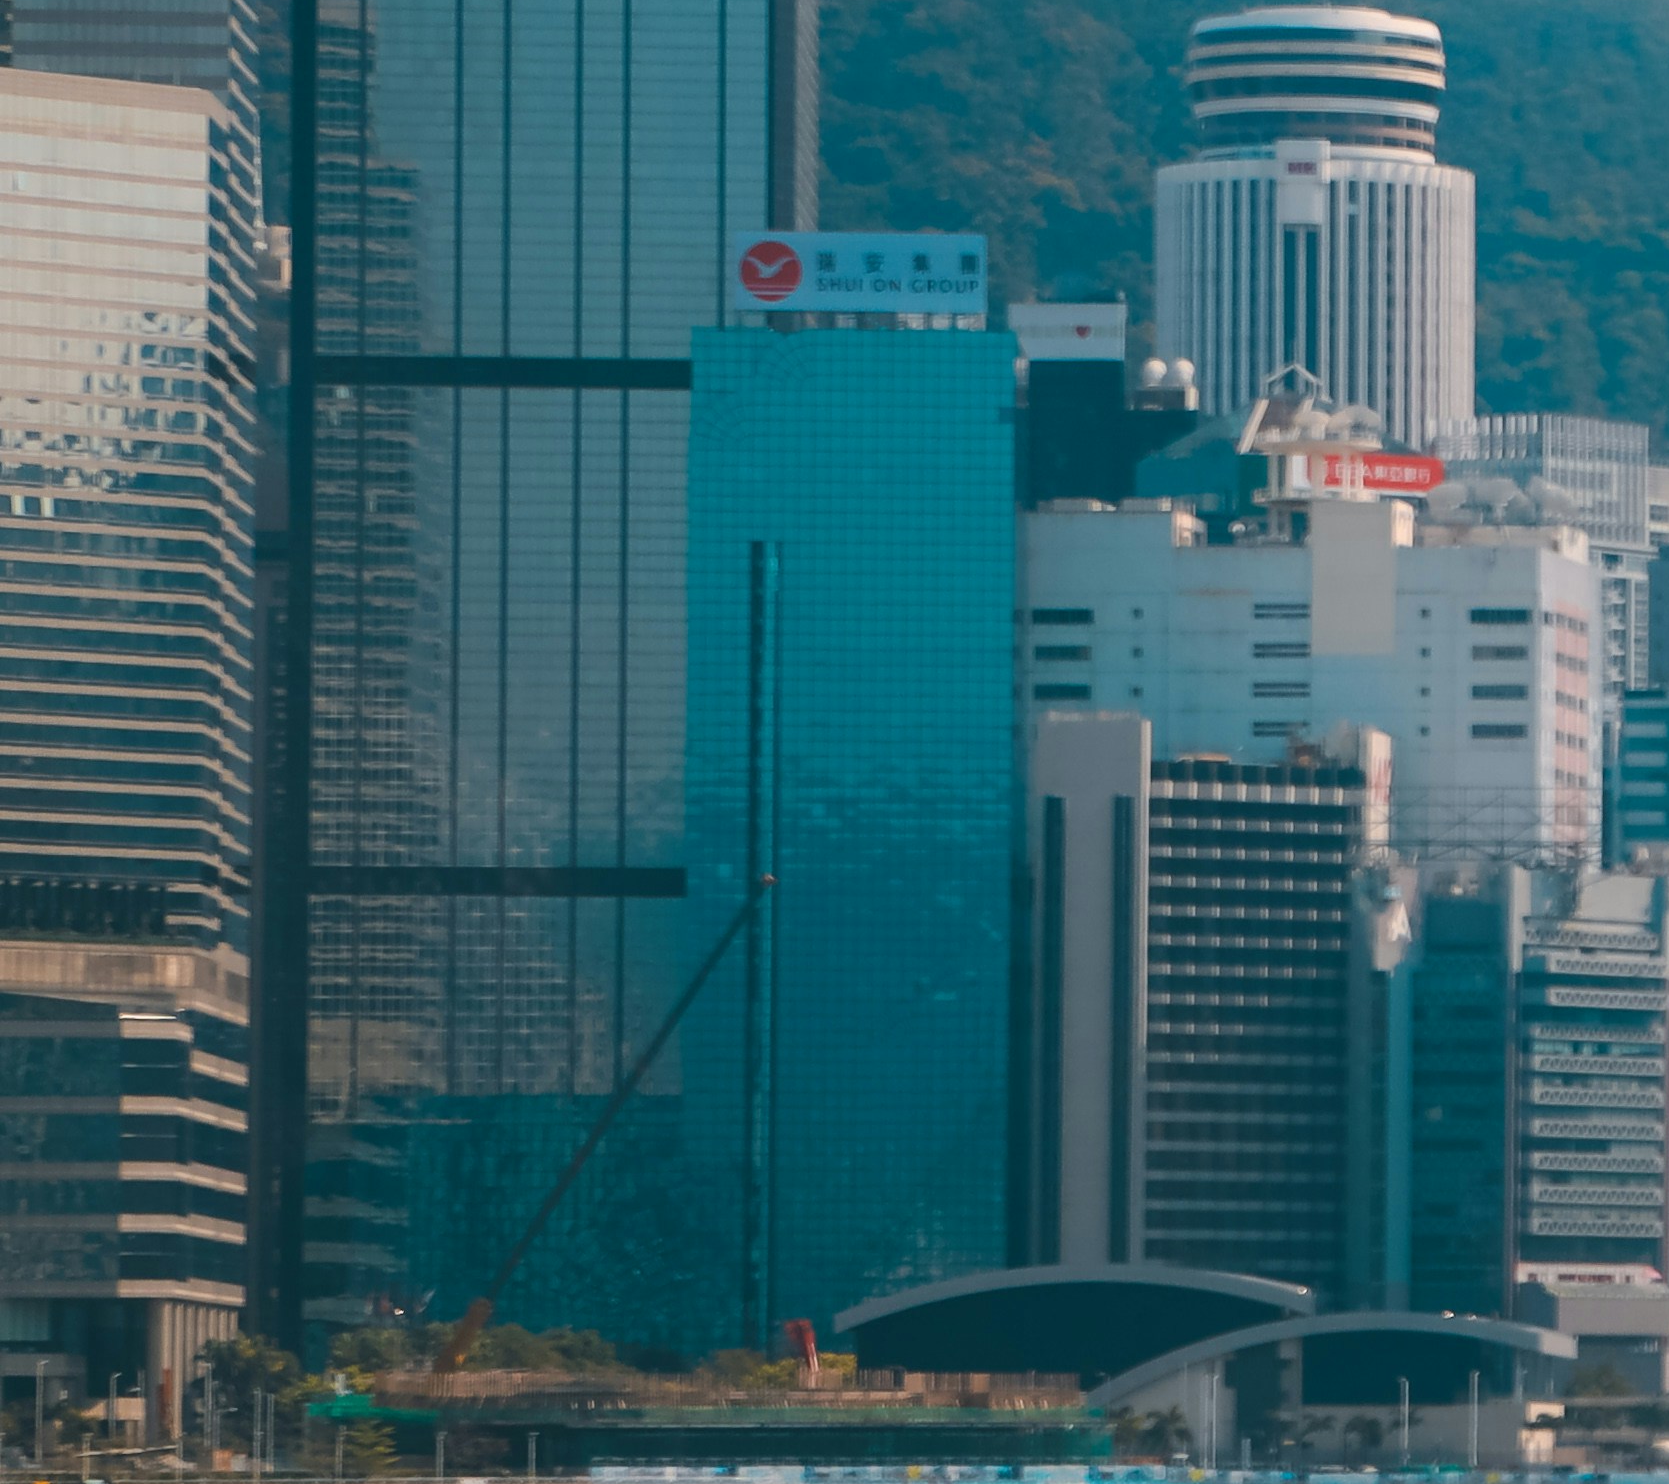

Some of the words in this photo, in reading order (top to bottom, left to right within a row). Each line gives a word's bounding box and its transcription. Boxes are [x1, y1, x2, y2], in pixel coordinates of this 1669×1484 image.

[816, 278, 863, 292] SHUI
[873, 278, 902, 293] ON
[911, 278, 980, 294] GROUP
